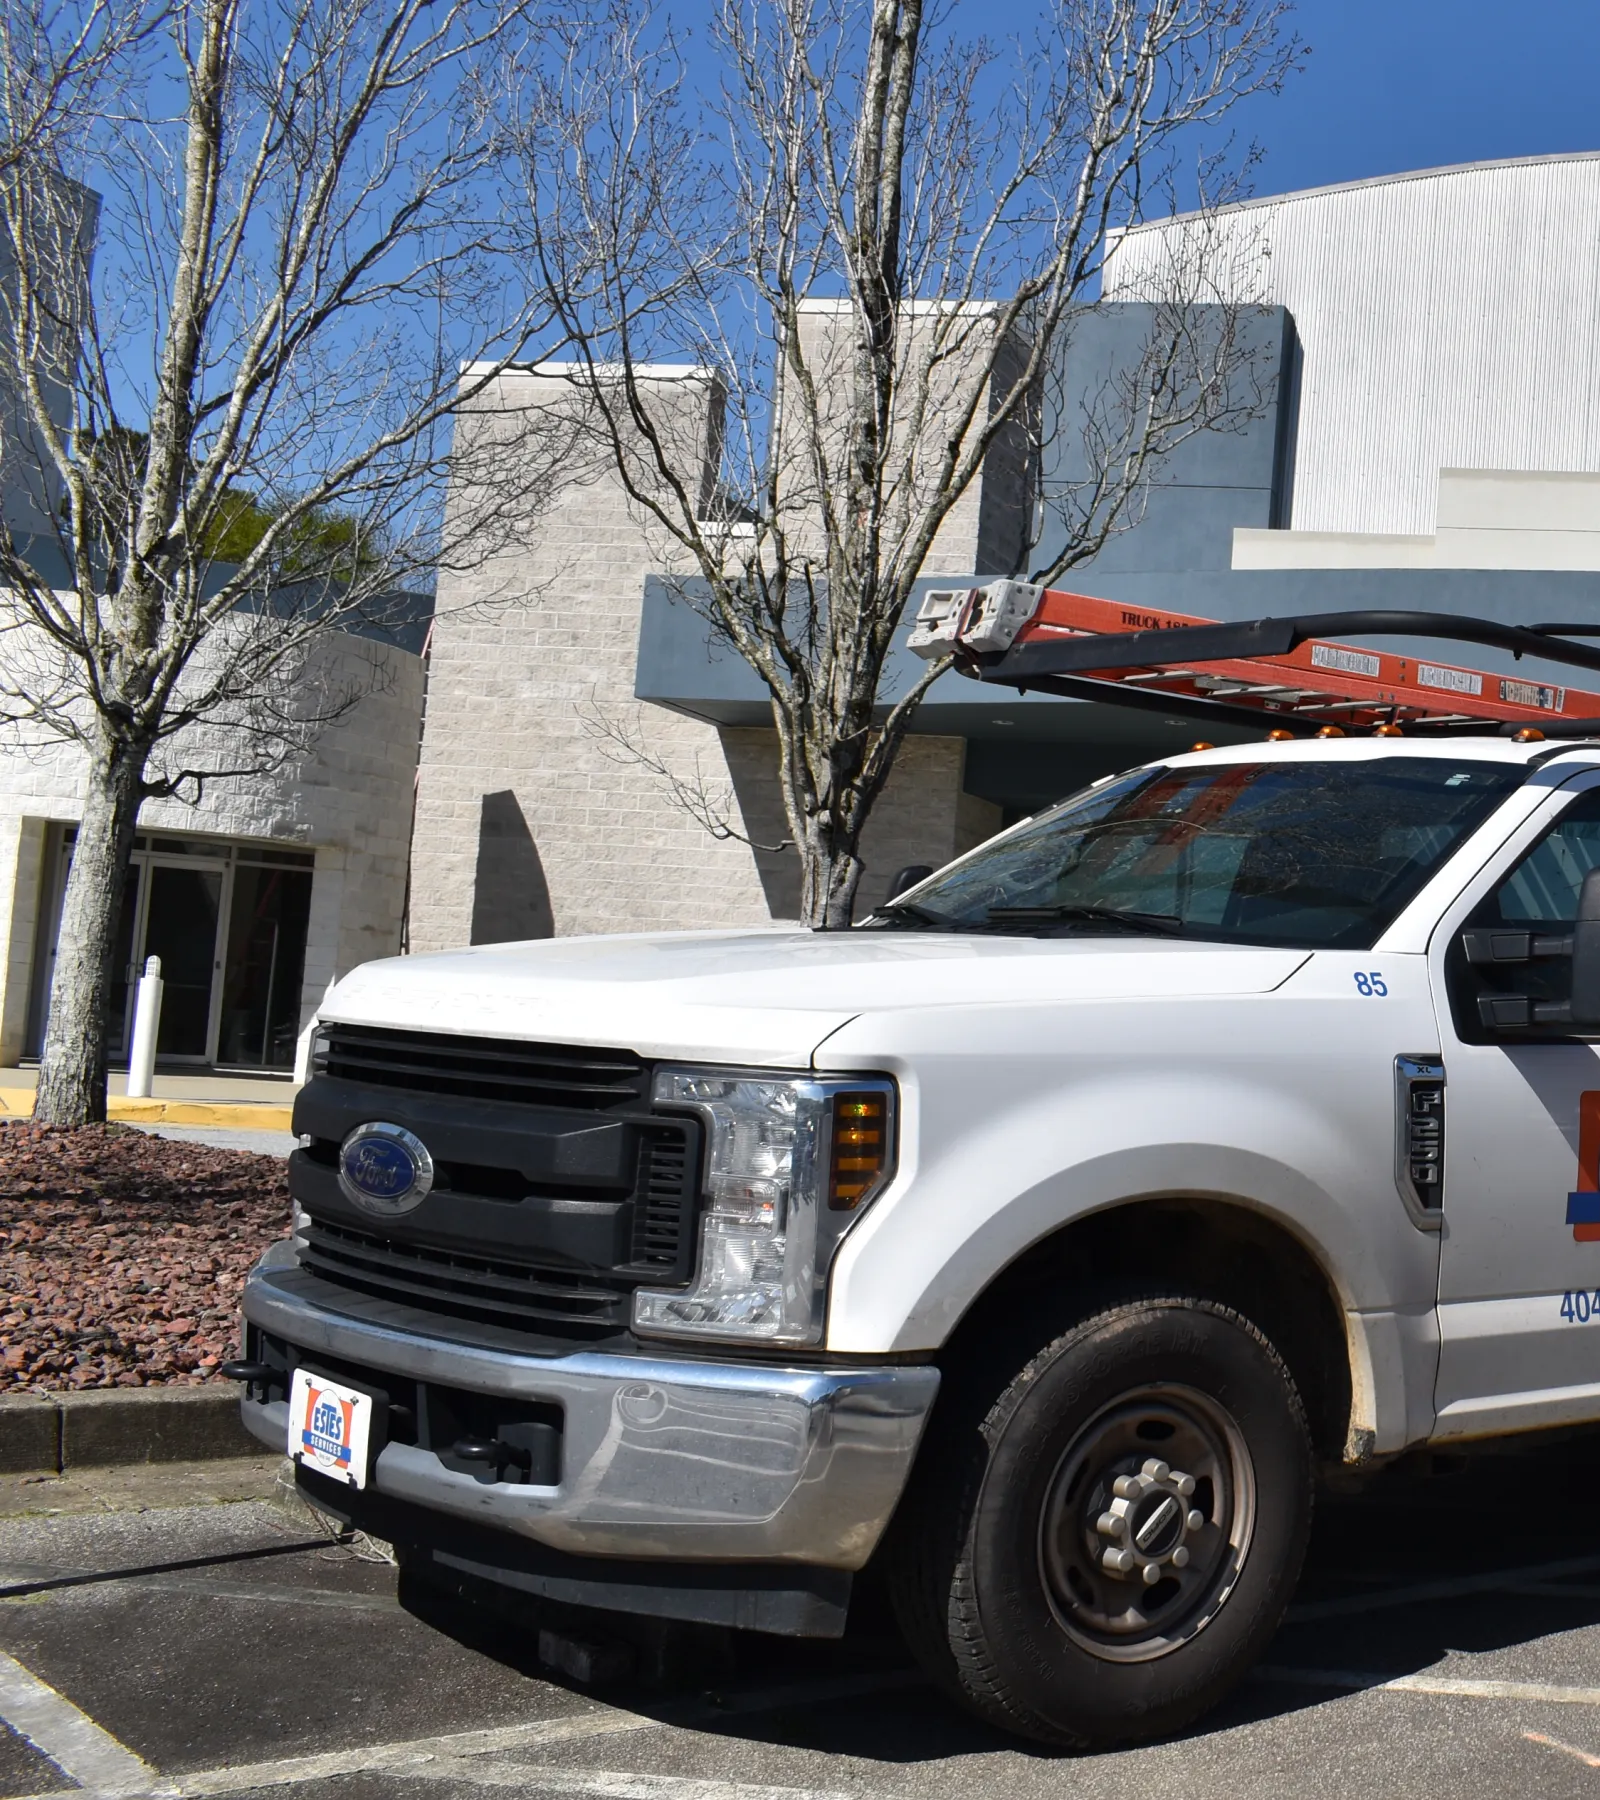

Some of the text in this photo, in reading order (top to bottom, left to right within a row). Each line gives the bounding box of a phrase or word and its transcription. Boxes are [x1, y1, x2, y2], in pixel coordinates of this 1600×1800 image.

[1120, 611, 1160, 630] TRUCK
[1353, 971, 1388, 997] 85
[1416, 1066, 1432, 1074] XL
[355, 1145, 400, 1188] Ford
[314, 1402, 342, 1440] ESTES
[311, 1435, 342, 1456] SERVICES
